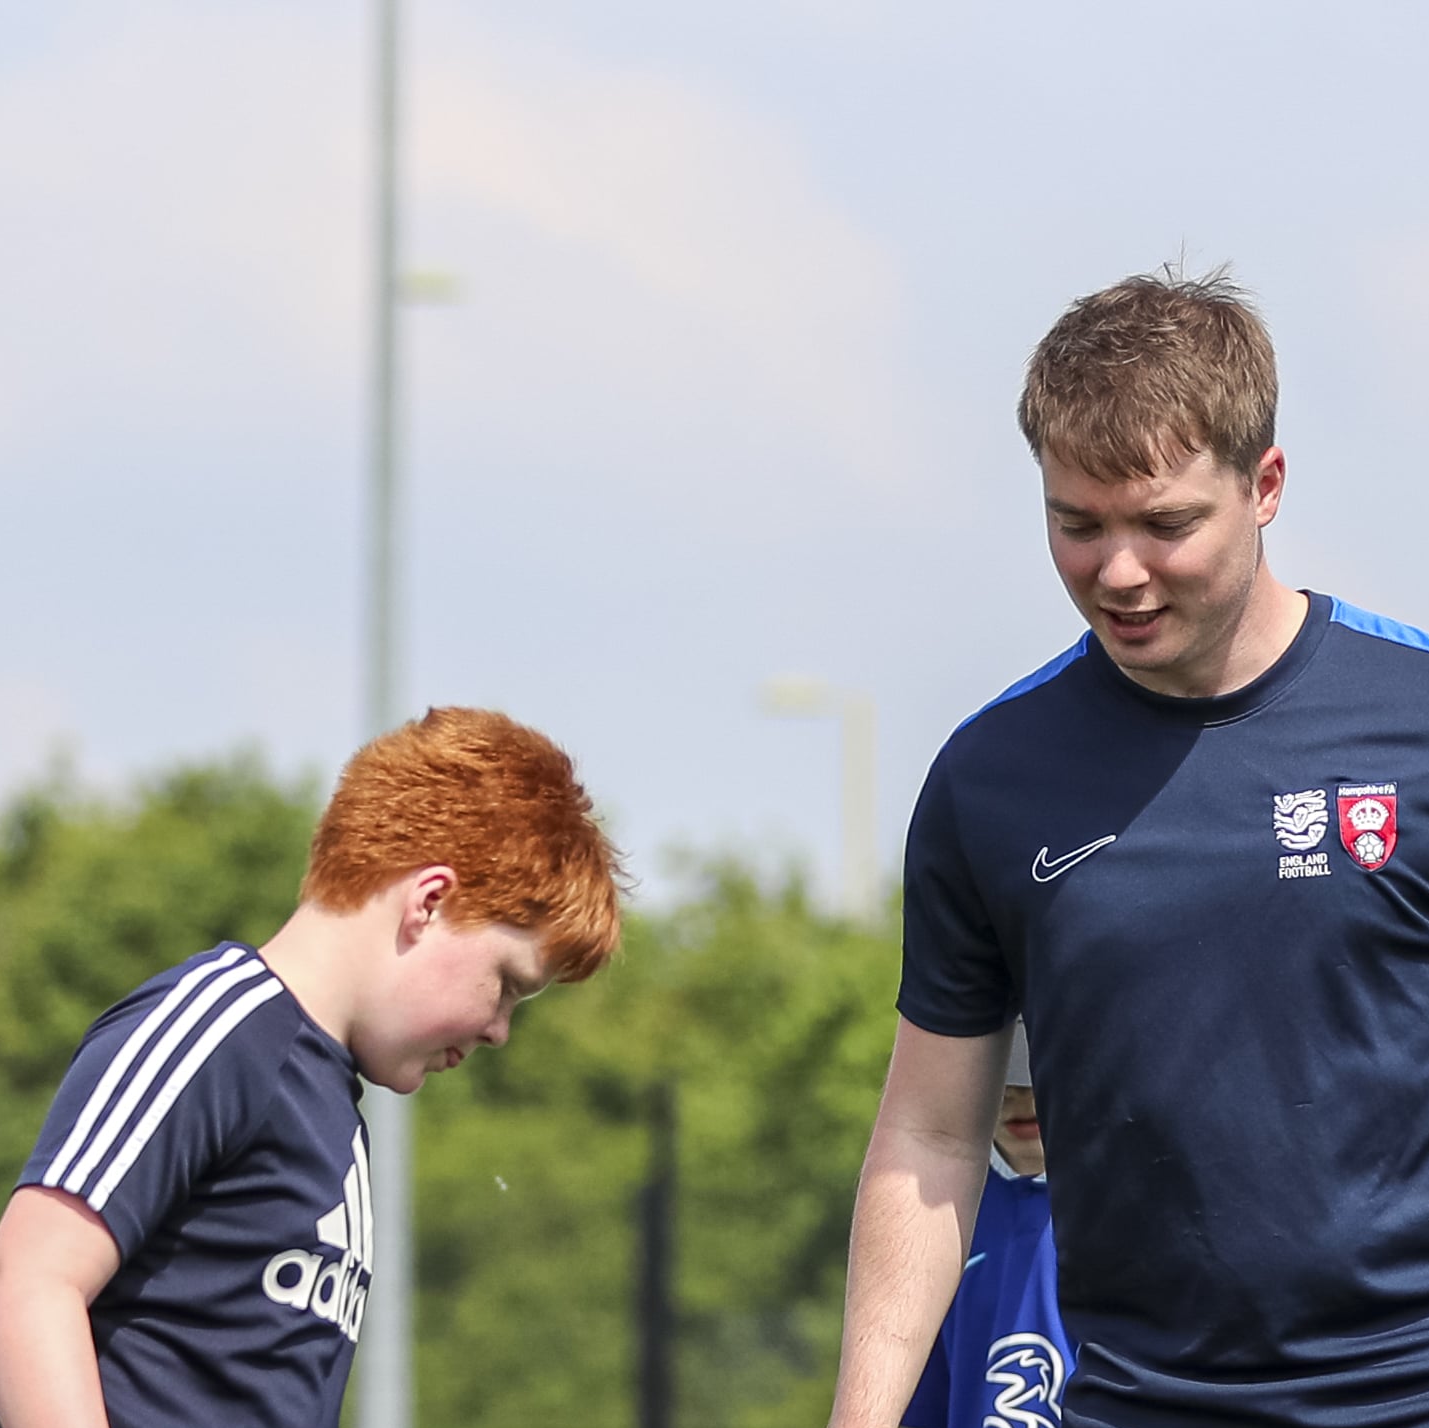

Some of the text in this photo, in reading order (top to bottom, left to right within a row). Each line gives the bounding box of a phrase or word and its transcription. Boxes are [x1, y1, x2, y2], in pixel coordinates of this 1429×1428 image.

[1338, 783, 1396, 797] Hampshire FA
[1279, 852, 1328, 868] ENGLAND
[1278, 864, 1332, 879] FOOTBALL
